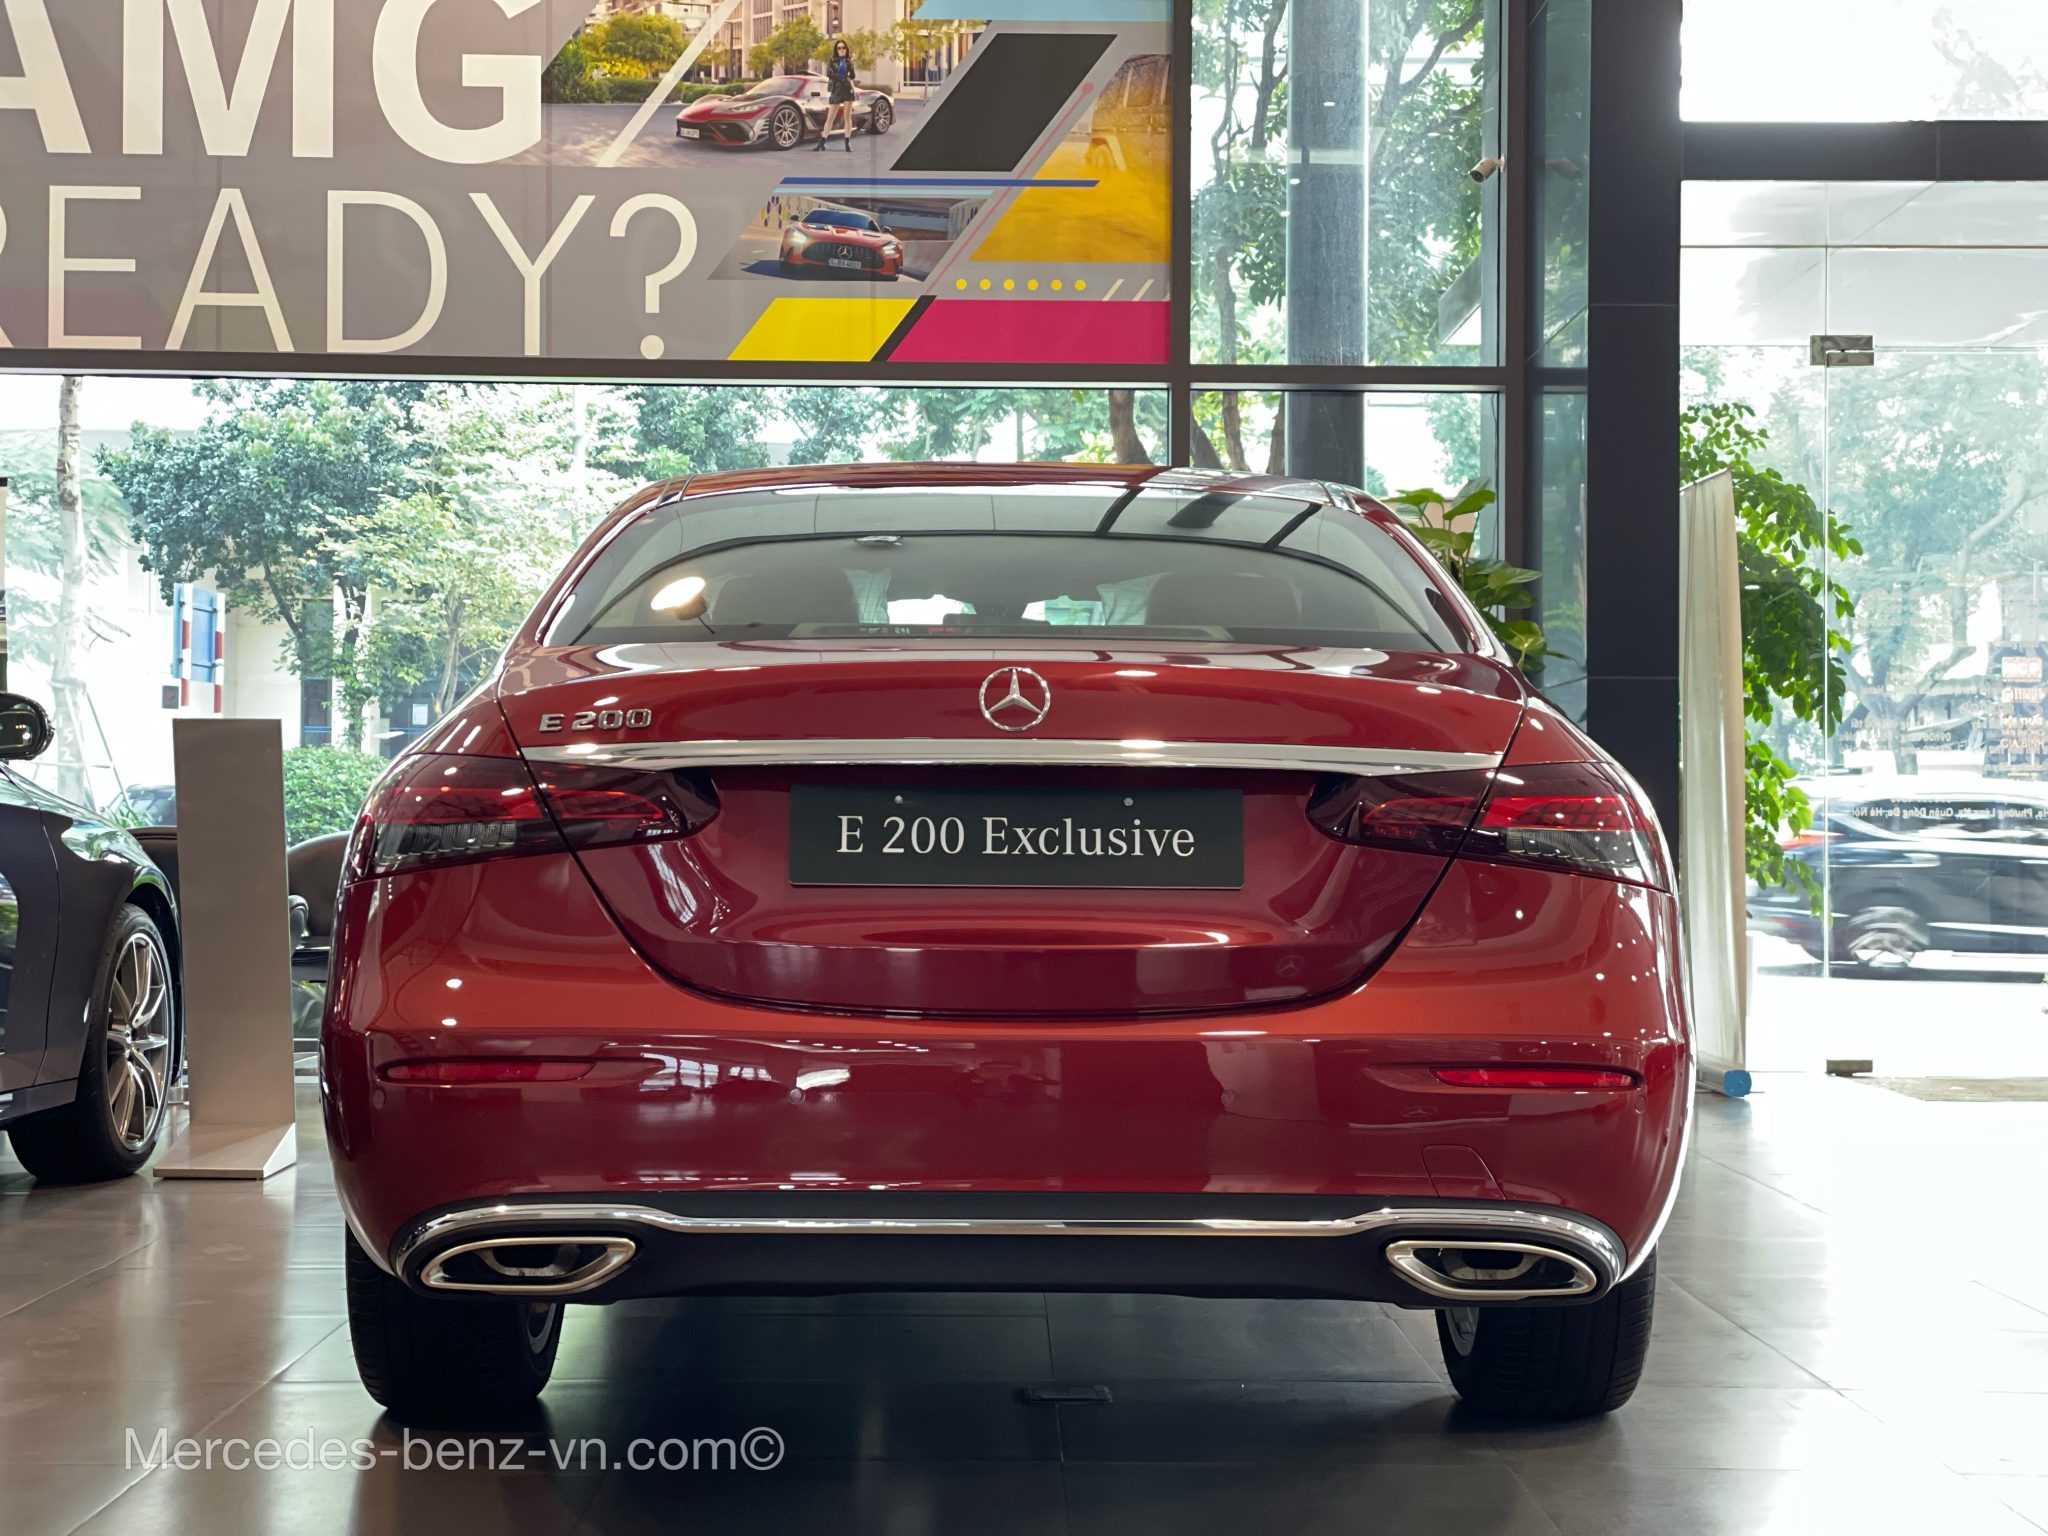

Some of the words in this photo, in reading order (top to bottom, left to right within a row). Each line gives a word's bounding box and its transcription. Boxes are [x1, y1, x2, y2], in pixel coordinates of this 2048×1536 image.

[0, 185, 698, 360] EADY?
[539, 712, 565, 732] E
[571, 708, 652, 731] 200
[836, 815, 864, 853] E
[881, 816, 965, 855] 200
[981, 816, 1195, 857] Exclusive
